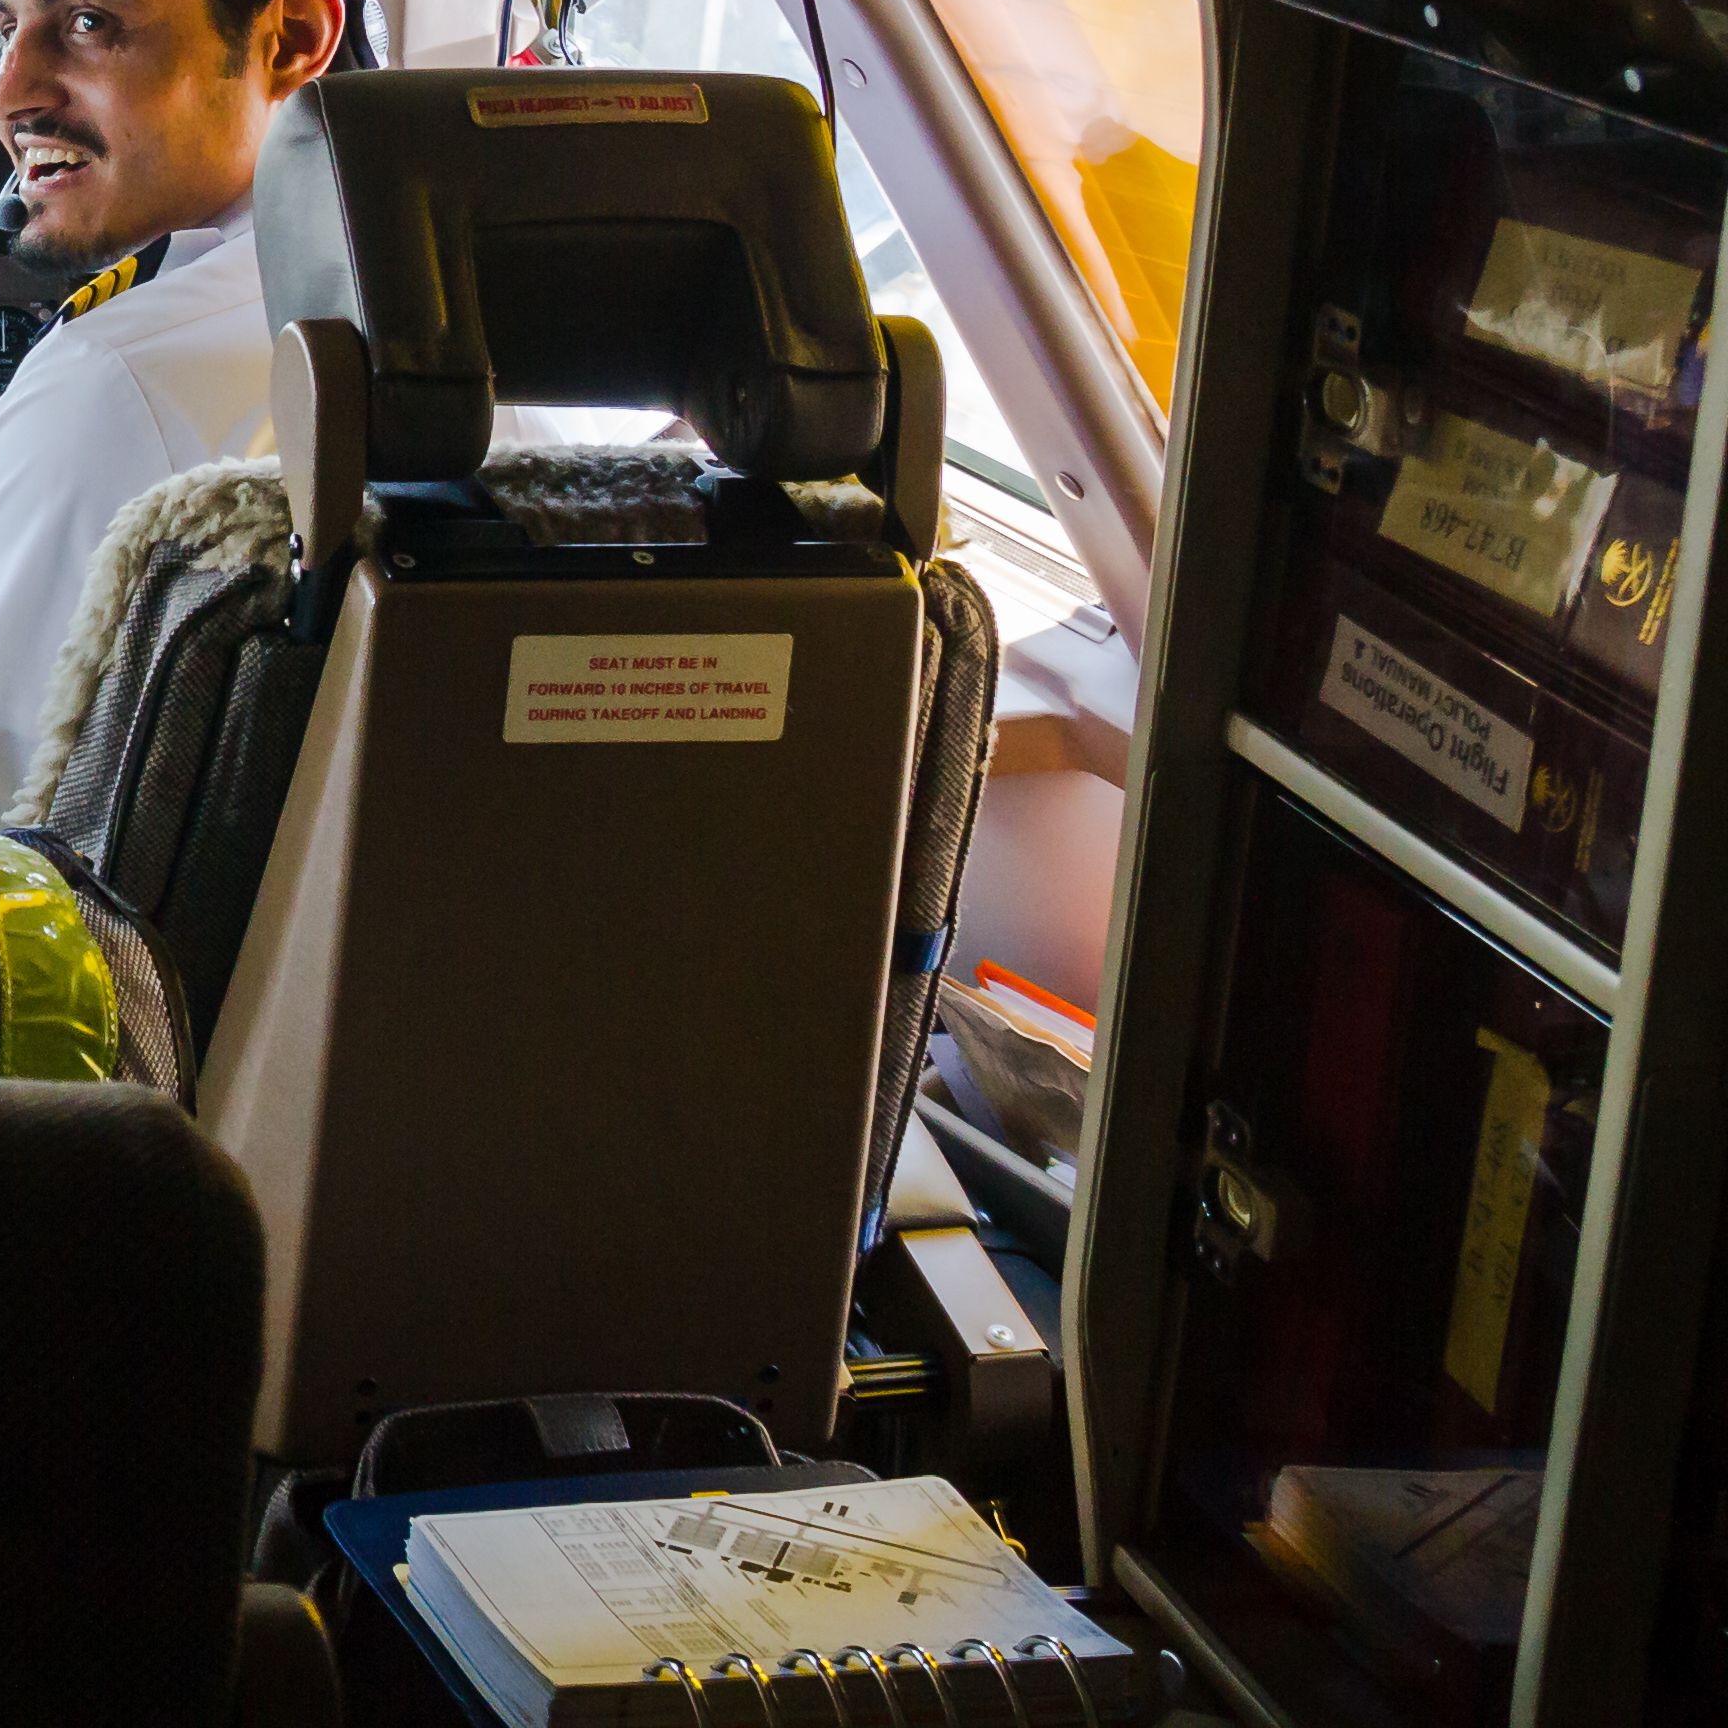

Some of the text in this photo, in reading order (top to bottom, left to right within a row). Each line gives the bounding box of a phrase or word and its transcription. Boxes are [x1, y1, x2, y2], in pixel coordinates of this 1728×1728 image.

[615, 96, 635, 110] TO
[640, 96, 694, 111] ADJUST
[589, 657, 717, 670] SEAT MUST BE IN
[528, 683, 605, 696] FORWARD
[630, 682, 685, 695] INCHES
[690, 682, 710, 695] OF
[715, 682, 771, 695] TRAVEL
[1371, 644, 1492, 741] POLICY MANUAL
[528, 707, 767, 721] DURING TAKEOFF AND LANDING
[1341, 662, 1511, 796] Flight Operations
